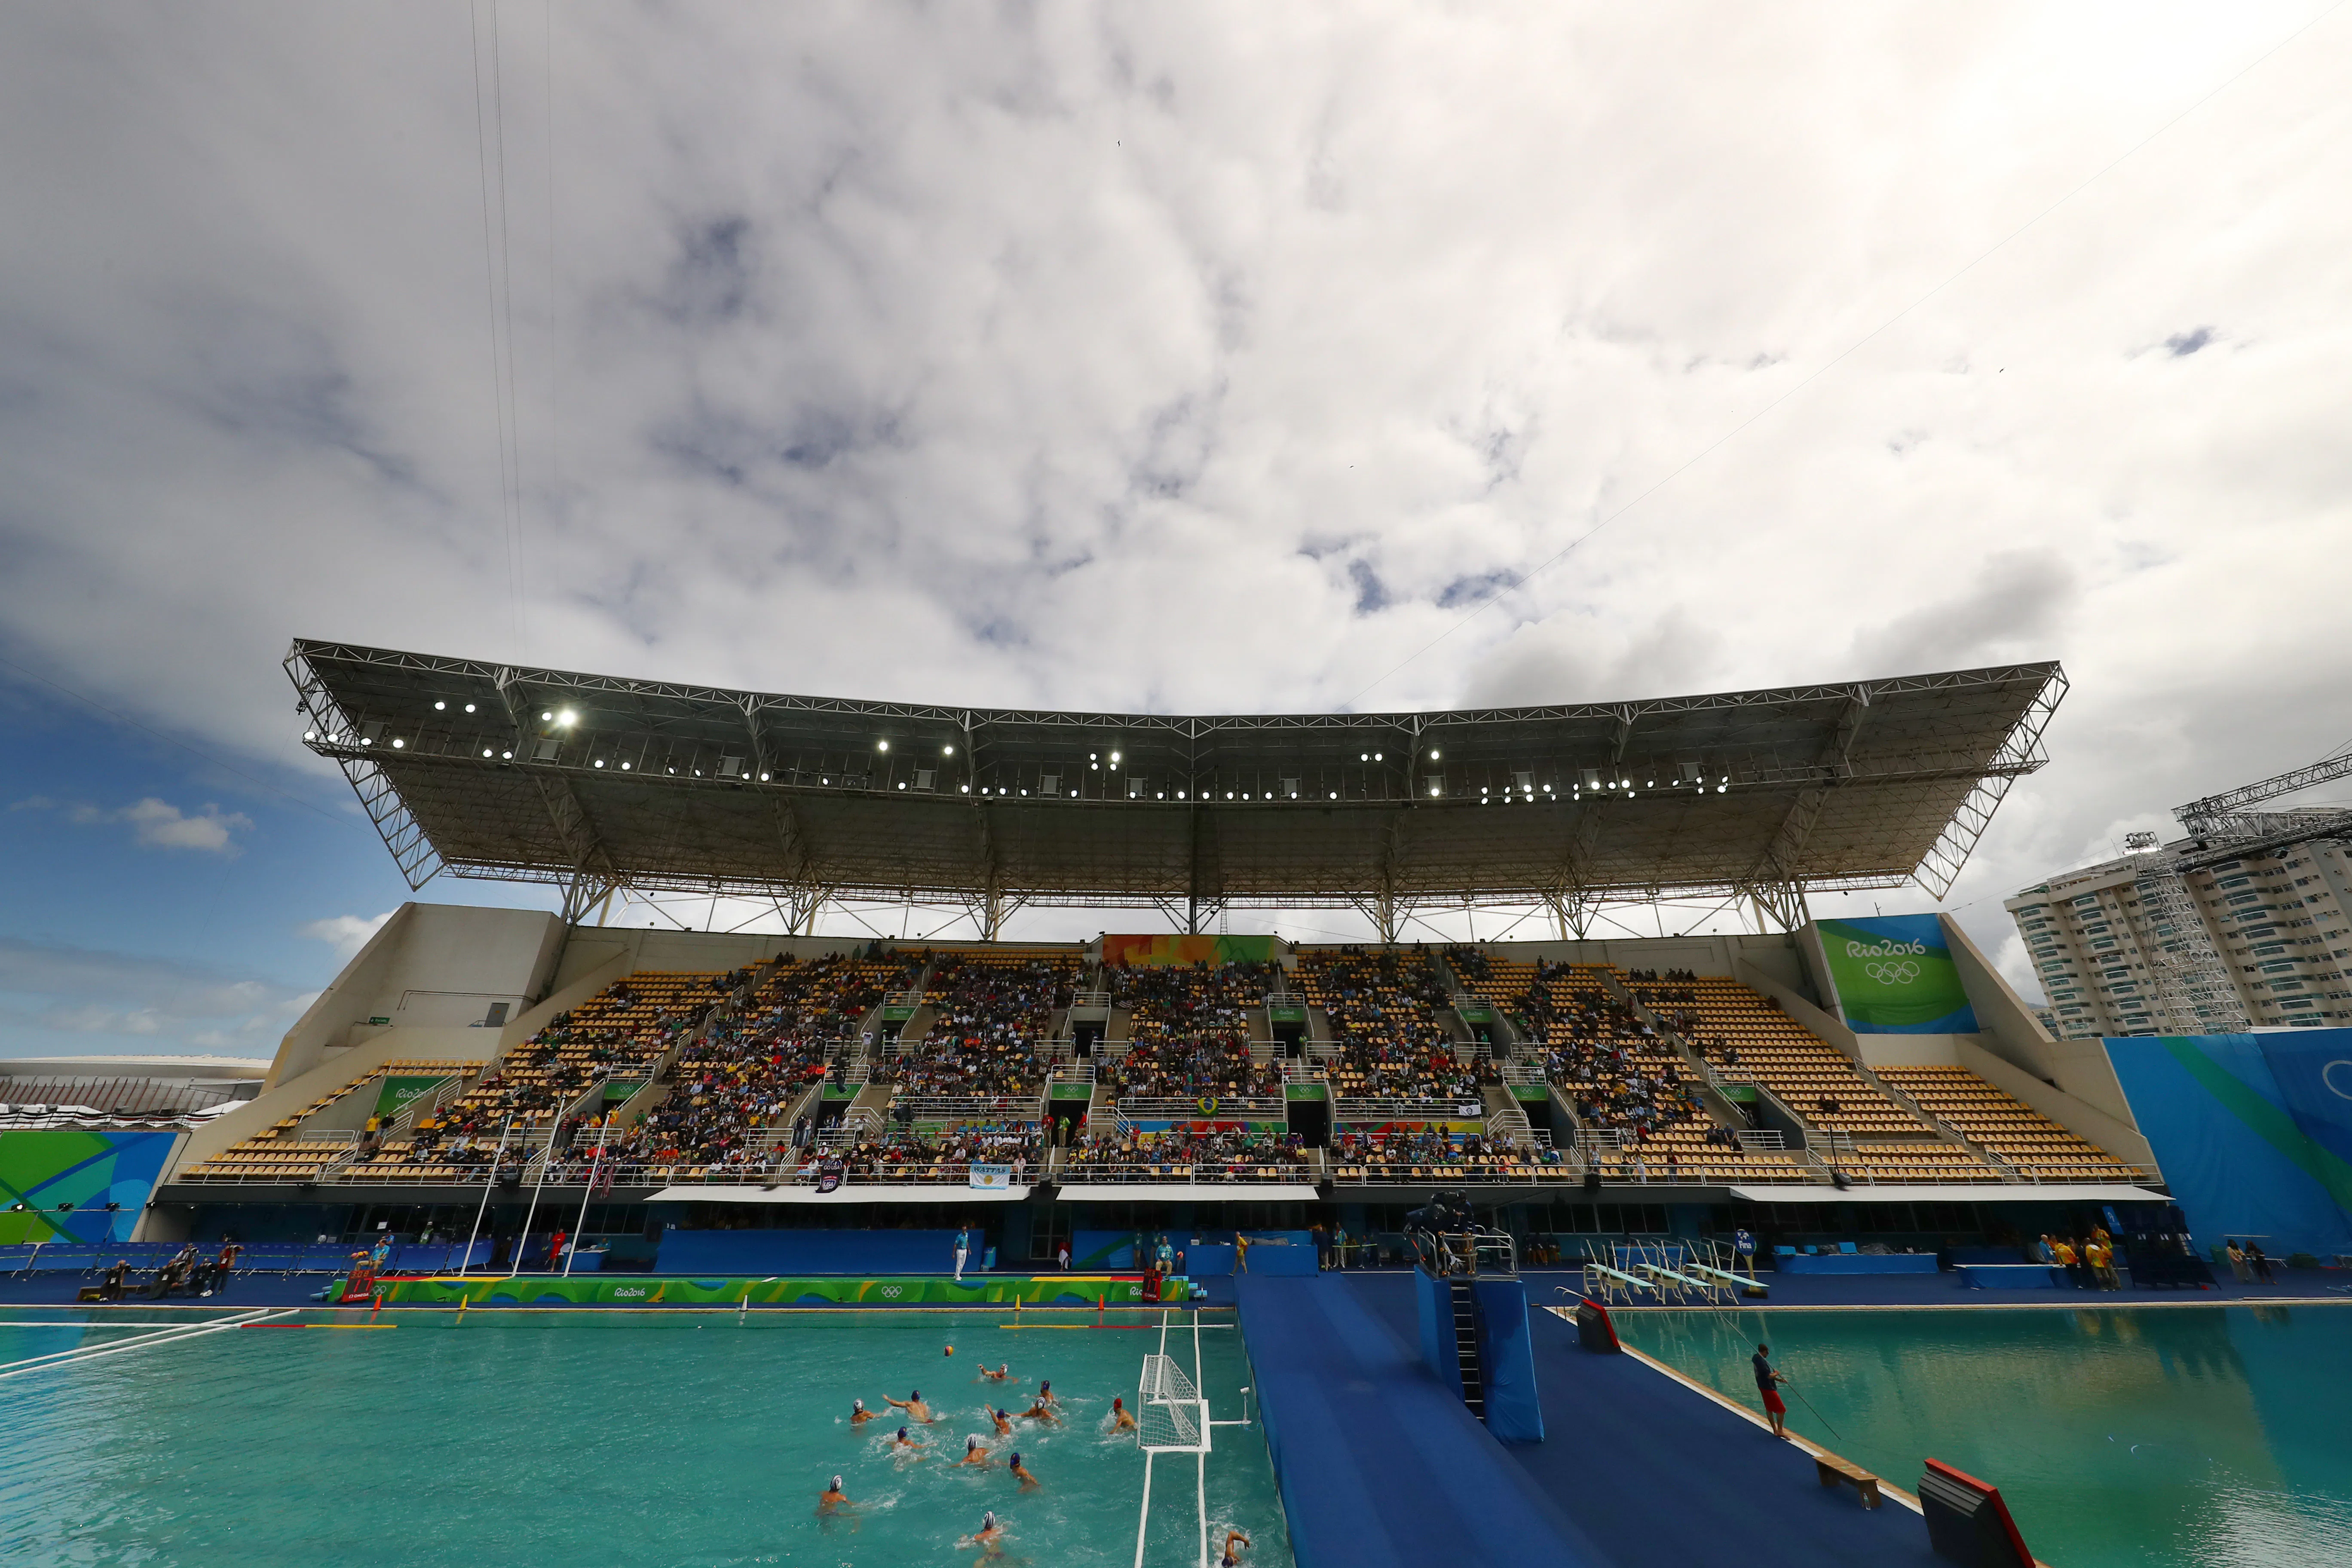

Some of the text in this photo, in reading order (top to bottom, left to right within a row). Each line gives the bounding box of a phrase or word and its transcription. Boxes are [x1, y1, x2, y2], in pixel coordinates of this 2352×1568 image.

[1847, 938, 1926, 958] Rio2016
[354, 1277, 373, 1292] 17
[614, 1288, 645, 1296] Rio2016
